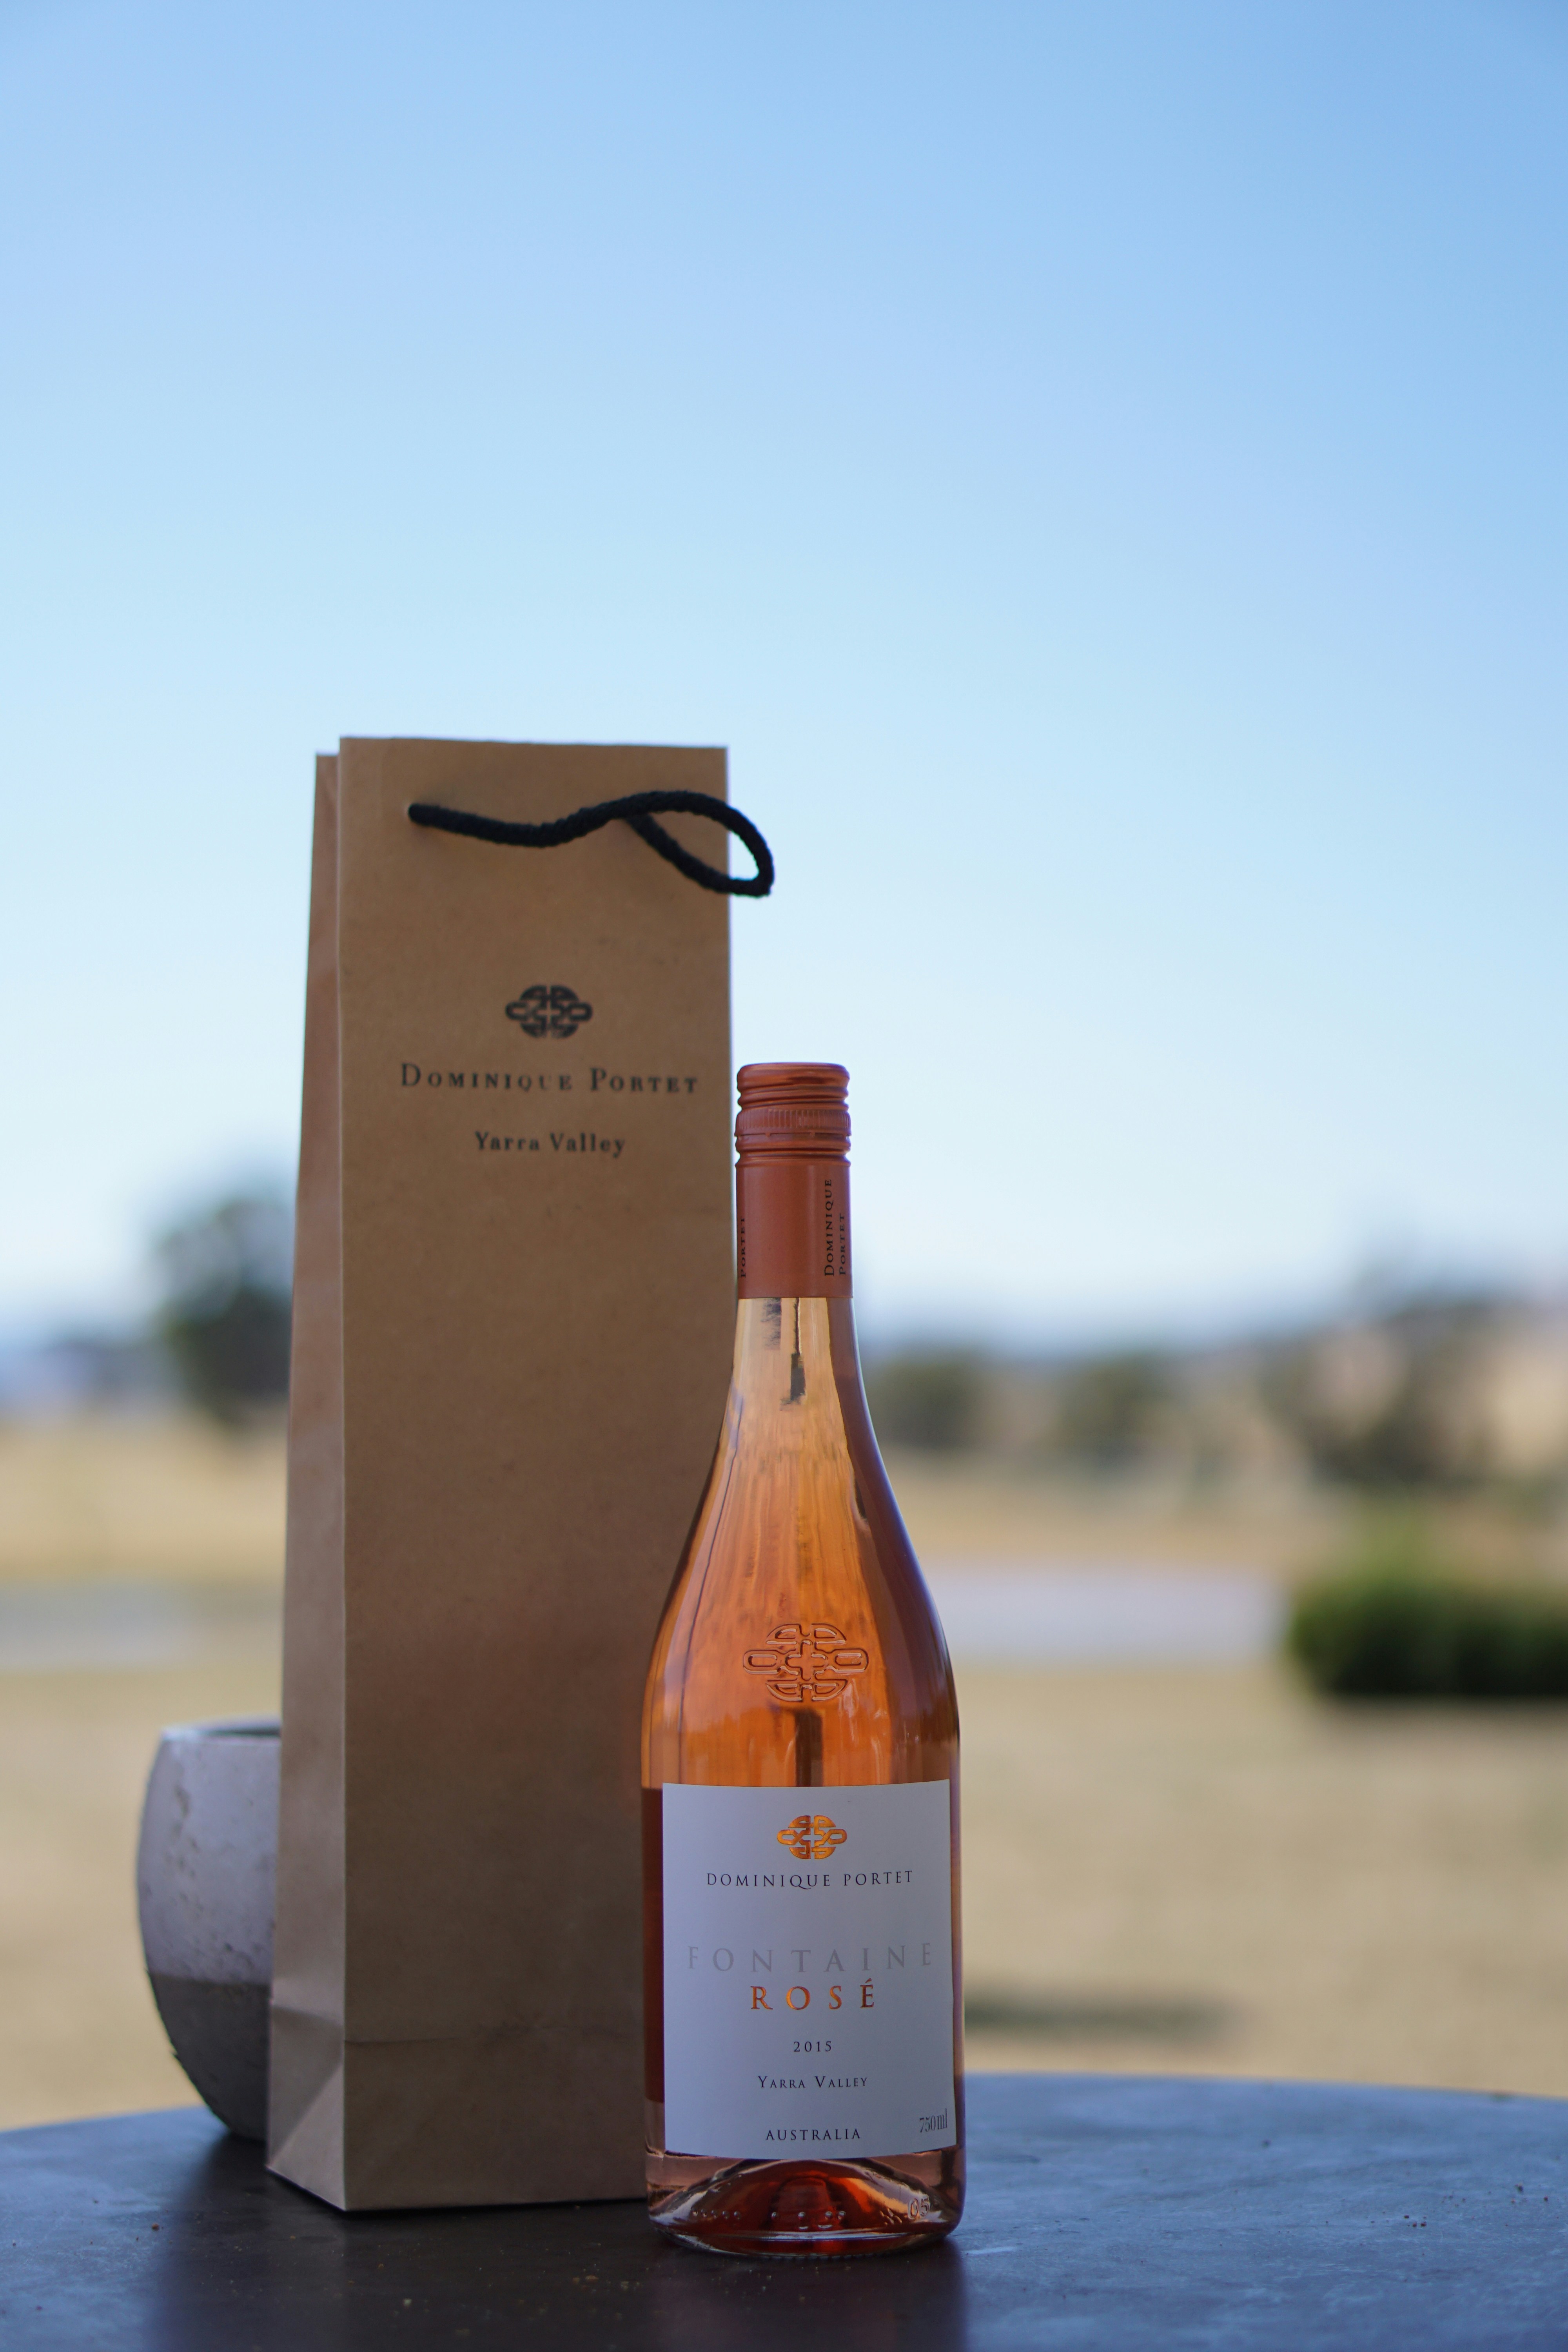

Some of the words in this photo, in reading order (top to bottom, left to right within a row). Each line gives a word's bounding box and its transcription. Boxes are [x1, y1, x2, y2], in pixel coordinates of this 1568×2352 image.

[401, 1063, 572, 1093] DOMINIQUE
[590, 1068, 699, 1094] PORTET
[475, 1131, 540, 1151] Yarra
[550, 1132, 626, 1159] Valley
[824, 1179, 834, 1276] DOMINIQUE
[707, 1873, 831, 1890] DOMINIQUE
[843, 1870, 913, 1886] PORTET
[688, 1942, 931, 1973] FONTAINE
[750, 1978, 875, 2010] ROSÉ
[793, 2041, 833, 2053] 2015
[757, 2076, 806, 2089] YARRA
[814, 2075, 868, 2088] VALLEY
[919, 2108, 948, 2133] 750ml
[765, 2128, 861, 2141] AUSTRALIA
